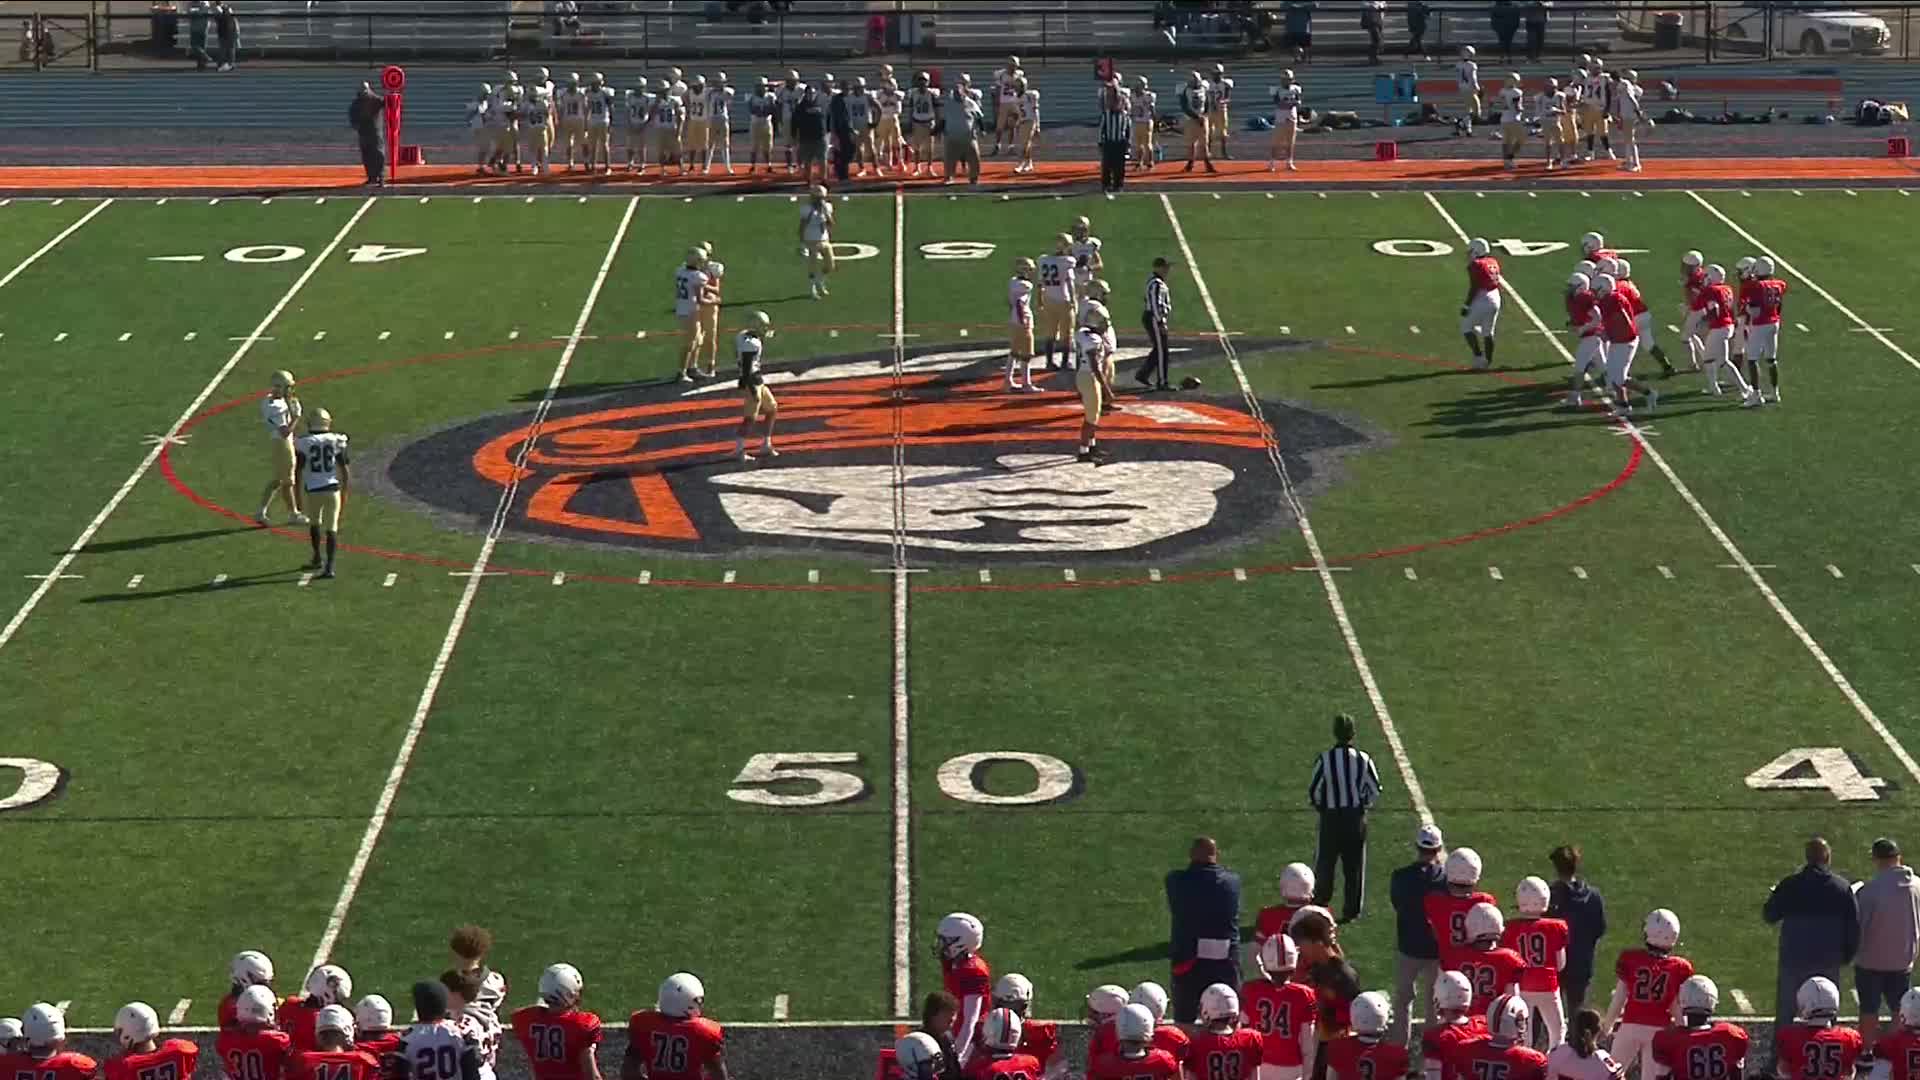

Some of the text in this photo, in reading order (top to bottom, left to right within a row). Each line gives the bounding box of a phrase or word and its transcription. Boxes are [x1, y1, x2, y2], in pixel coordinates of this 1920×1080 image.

[1517, 933, 1546, 968] 19
[1634, 967, 1669, 1002] 24
[1256, 998, 1291, 1039] 34
[529, 1024, 566, 1063] 78
[652, 1032, 689, 1072] 76
[1802, 1041, 1843, 1078] 35
[416, 1045, 457, 1080] 20
[1208, 1050, 1242, 1080] 83
[1688, 1044, 1728, 1080] 66
